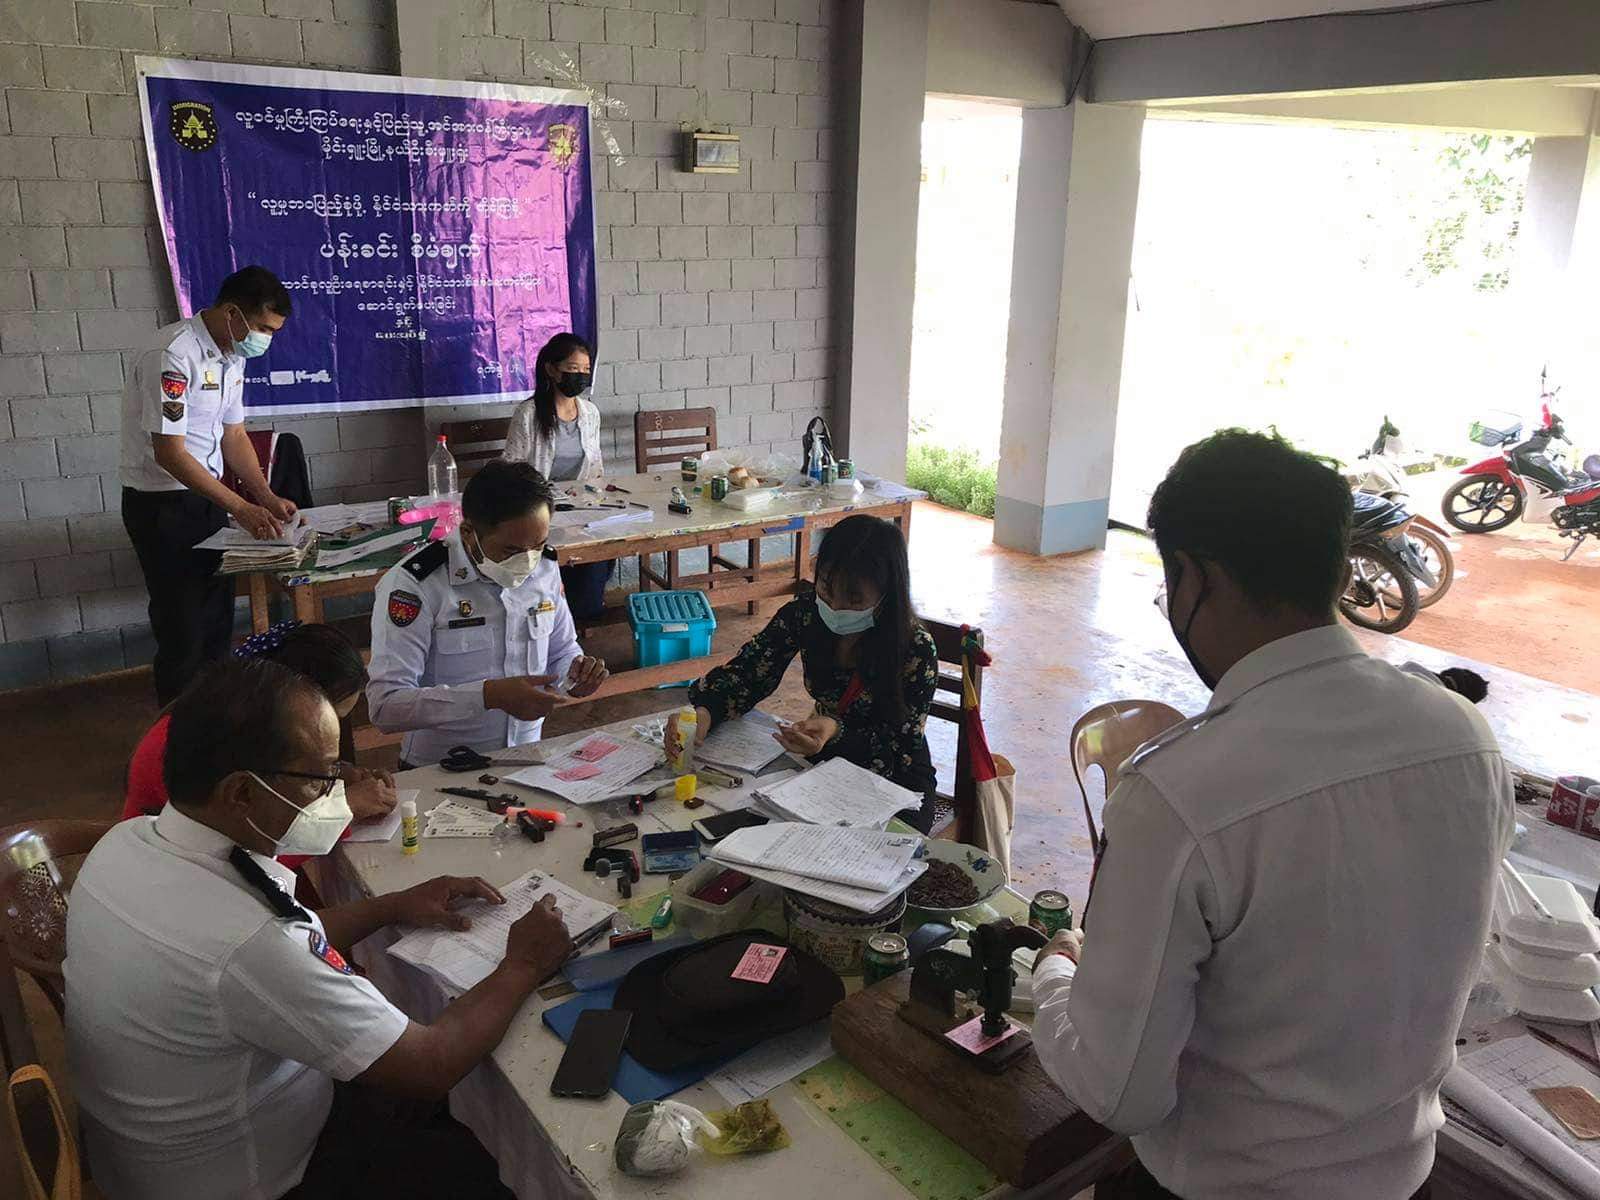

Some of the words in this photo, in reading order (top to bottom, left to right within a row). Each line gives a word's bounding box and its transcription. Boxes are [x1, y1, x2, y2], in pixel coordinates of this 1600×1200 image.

[320, 232, 398, 269] ပန်းခင်း
[411, 233, 486, 269] စီမံချက်
[357, 295, 456, 316] ဆောင်ရွက်ပေးခြင်း
